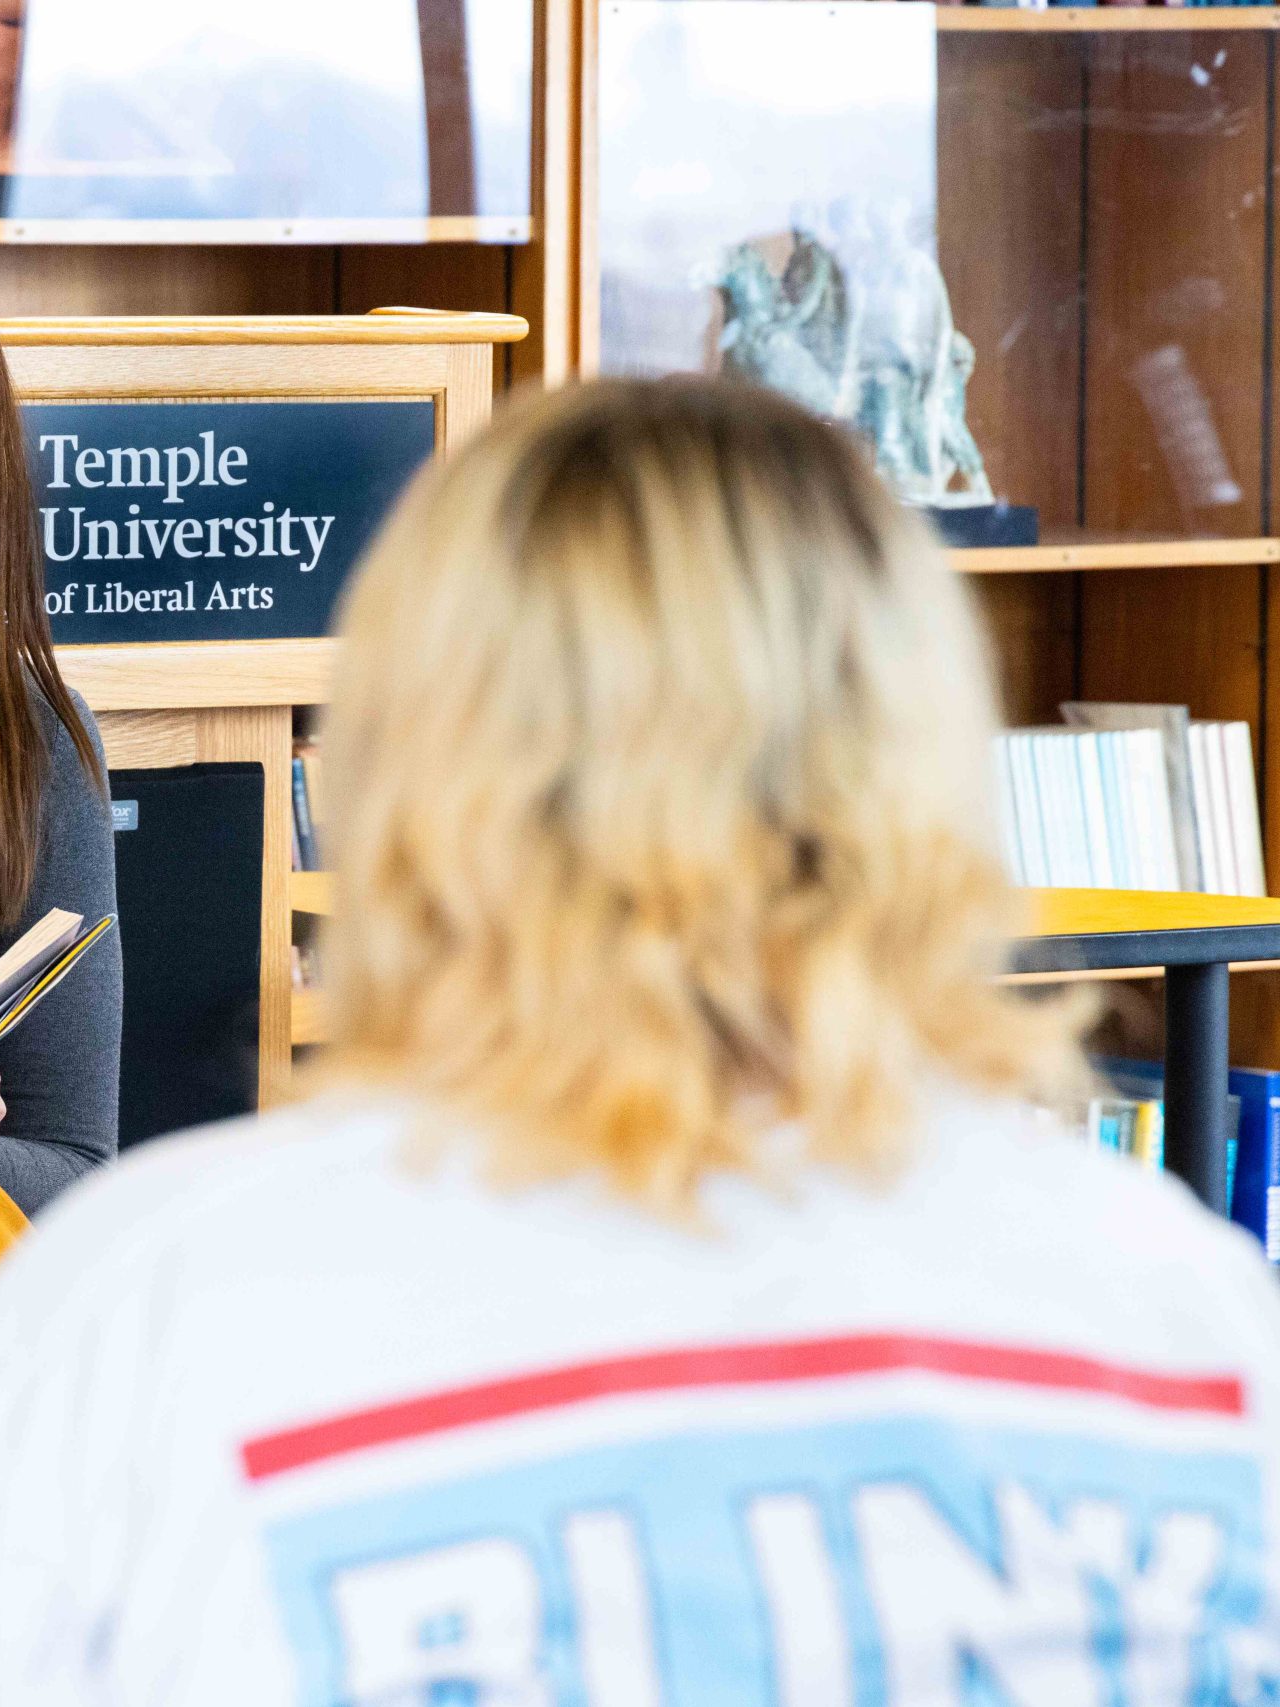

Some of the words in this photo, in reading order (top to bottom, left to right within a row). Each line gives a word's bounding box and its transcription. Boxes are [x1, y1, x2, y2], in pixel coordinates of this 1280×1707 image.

[38, 431, 248, 504] Temple
[38, 502, 336, 573] University
[44, 583, 79, 615] of
[85, 580, 196, 614] Liberal
[204, 580, 274, 611] Arts
